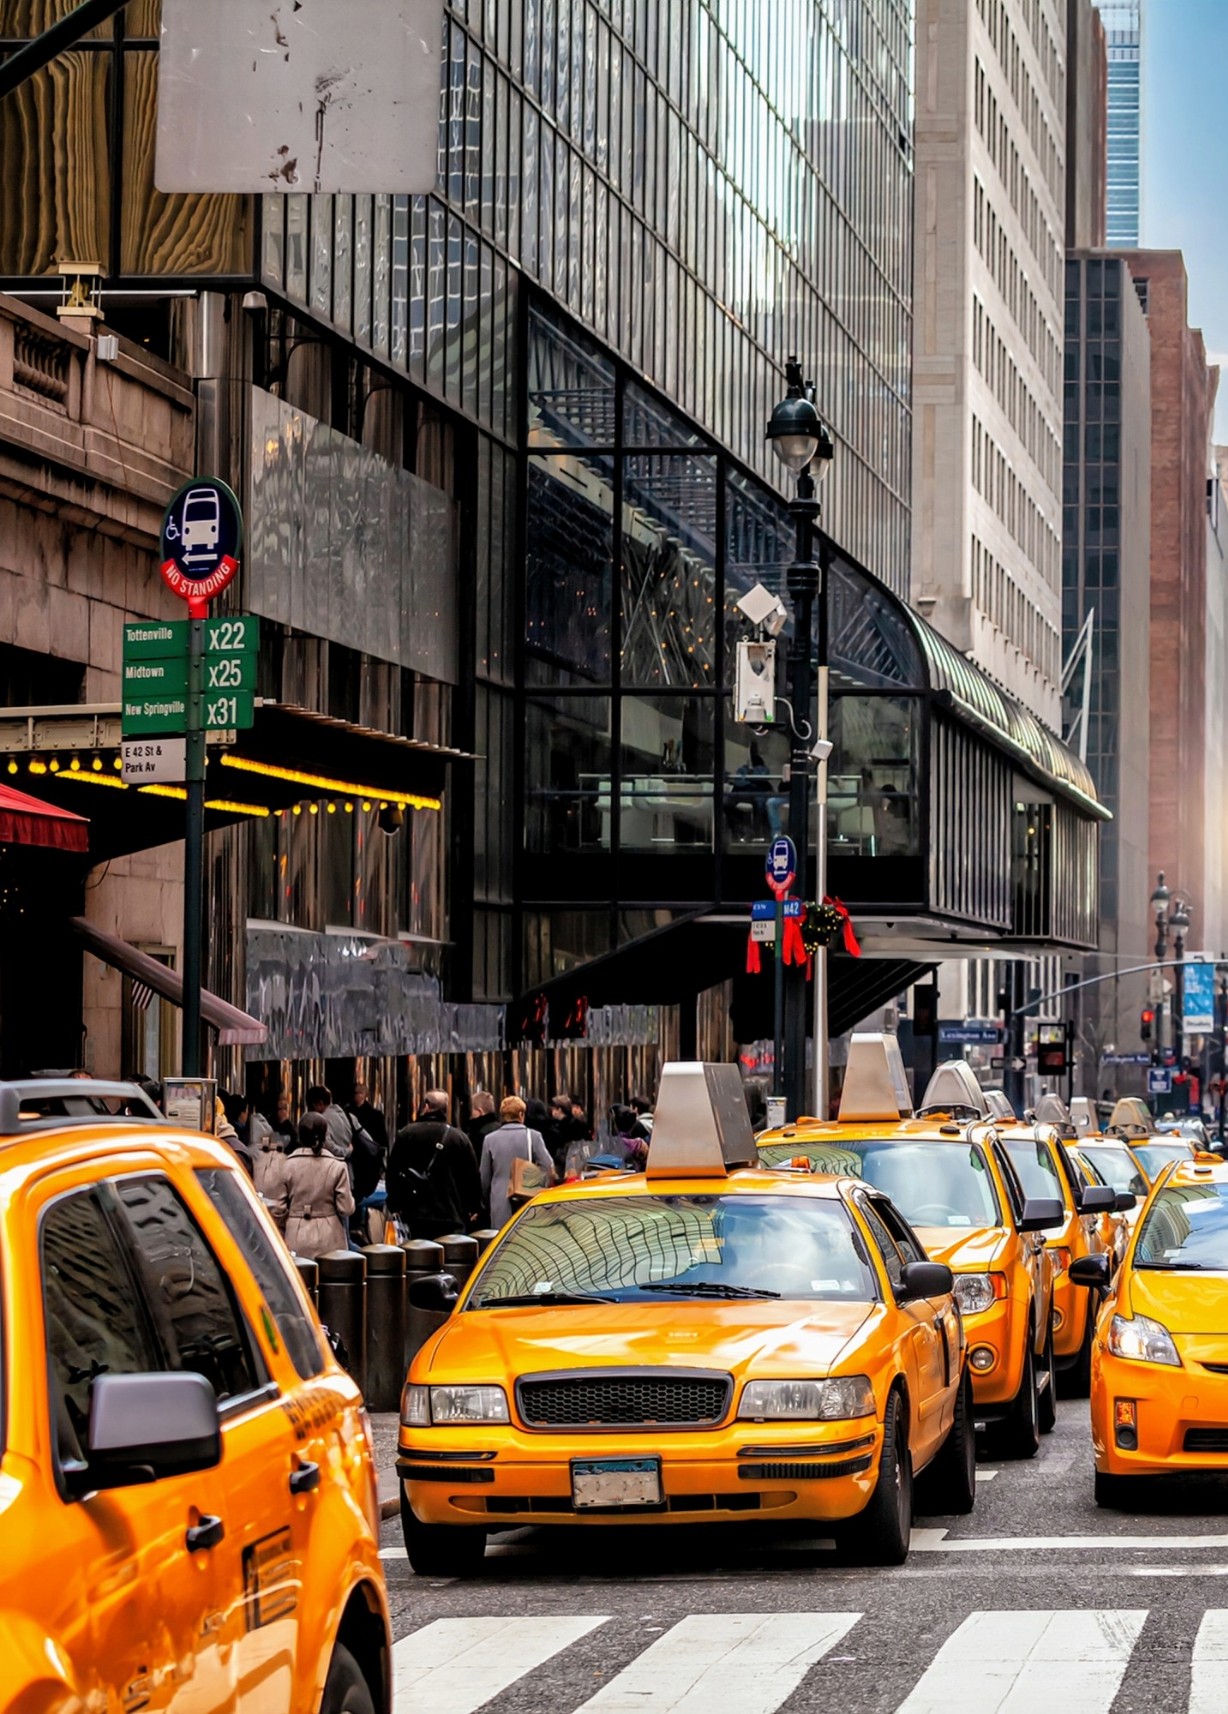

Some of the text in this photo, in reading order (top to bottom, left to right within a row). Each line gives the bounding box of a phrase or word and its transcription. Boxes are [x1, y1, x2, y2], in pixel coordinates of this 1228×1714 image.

[166, 563, 231, 596] NO STANDING
[126, 627, 173, 642] Tottenville
[125, 666, 165, 679] Midtown
[125, 700, 185, 718] New Springville
[125, 745, 162, 758] E 42 St &
[125, 761, 156, 773] Park Av
